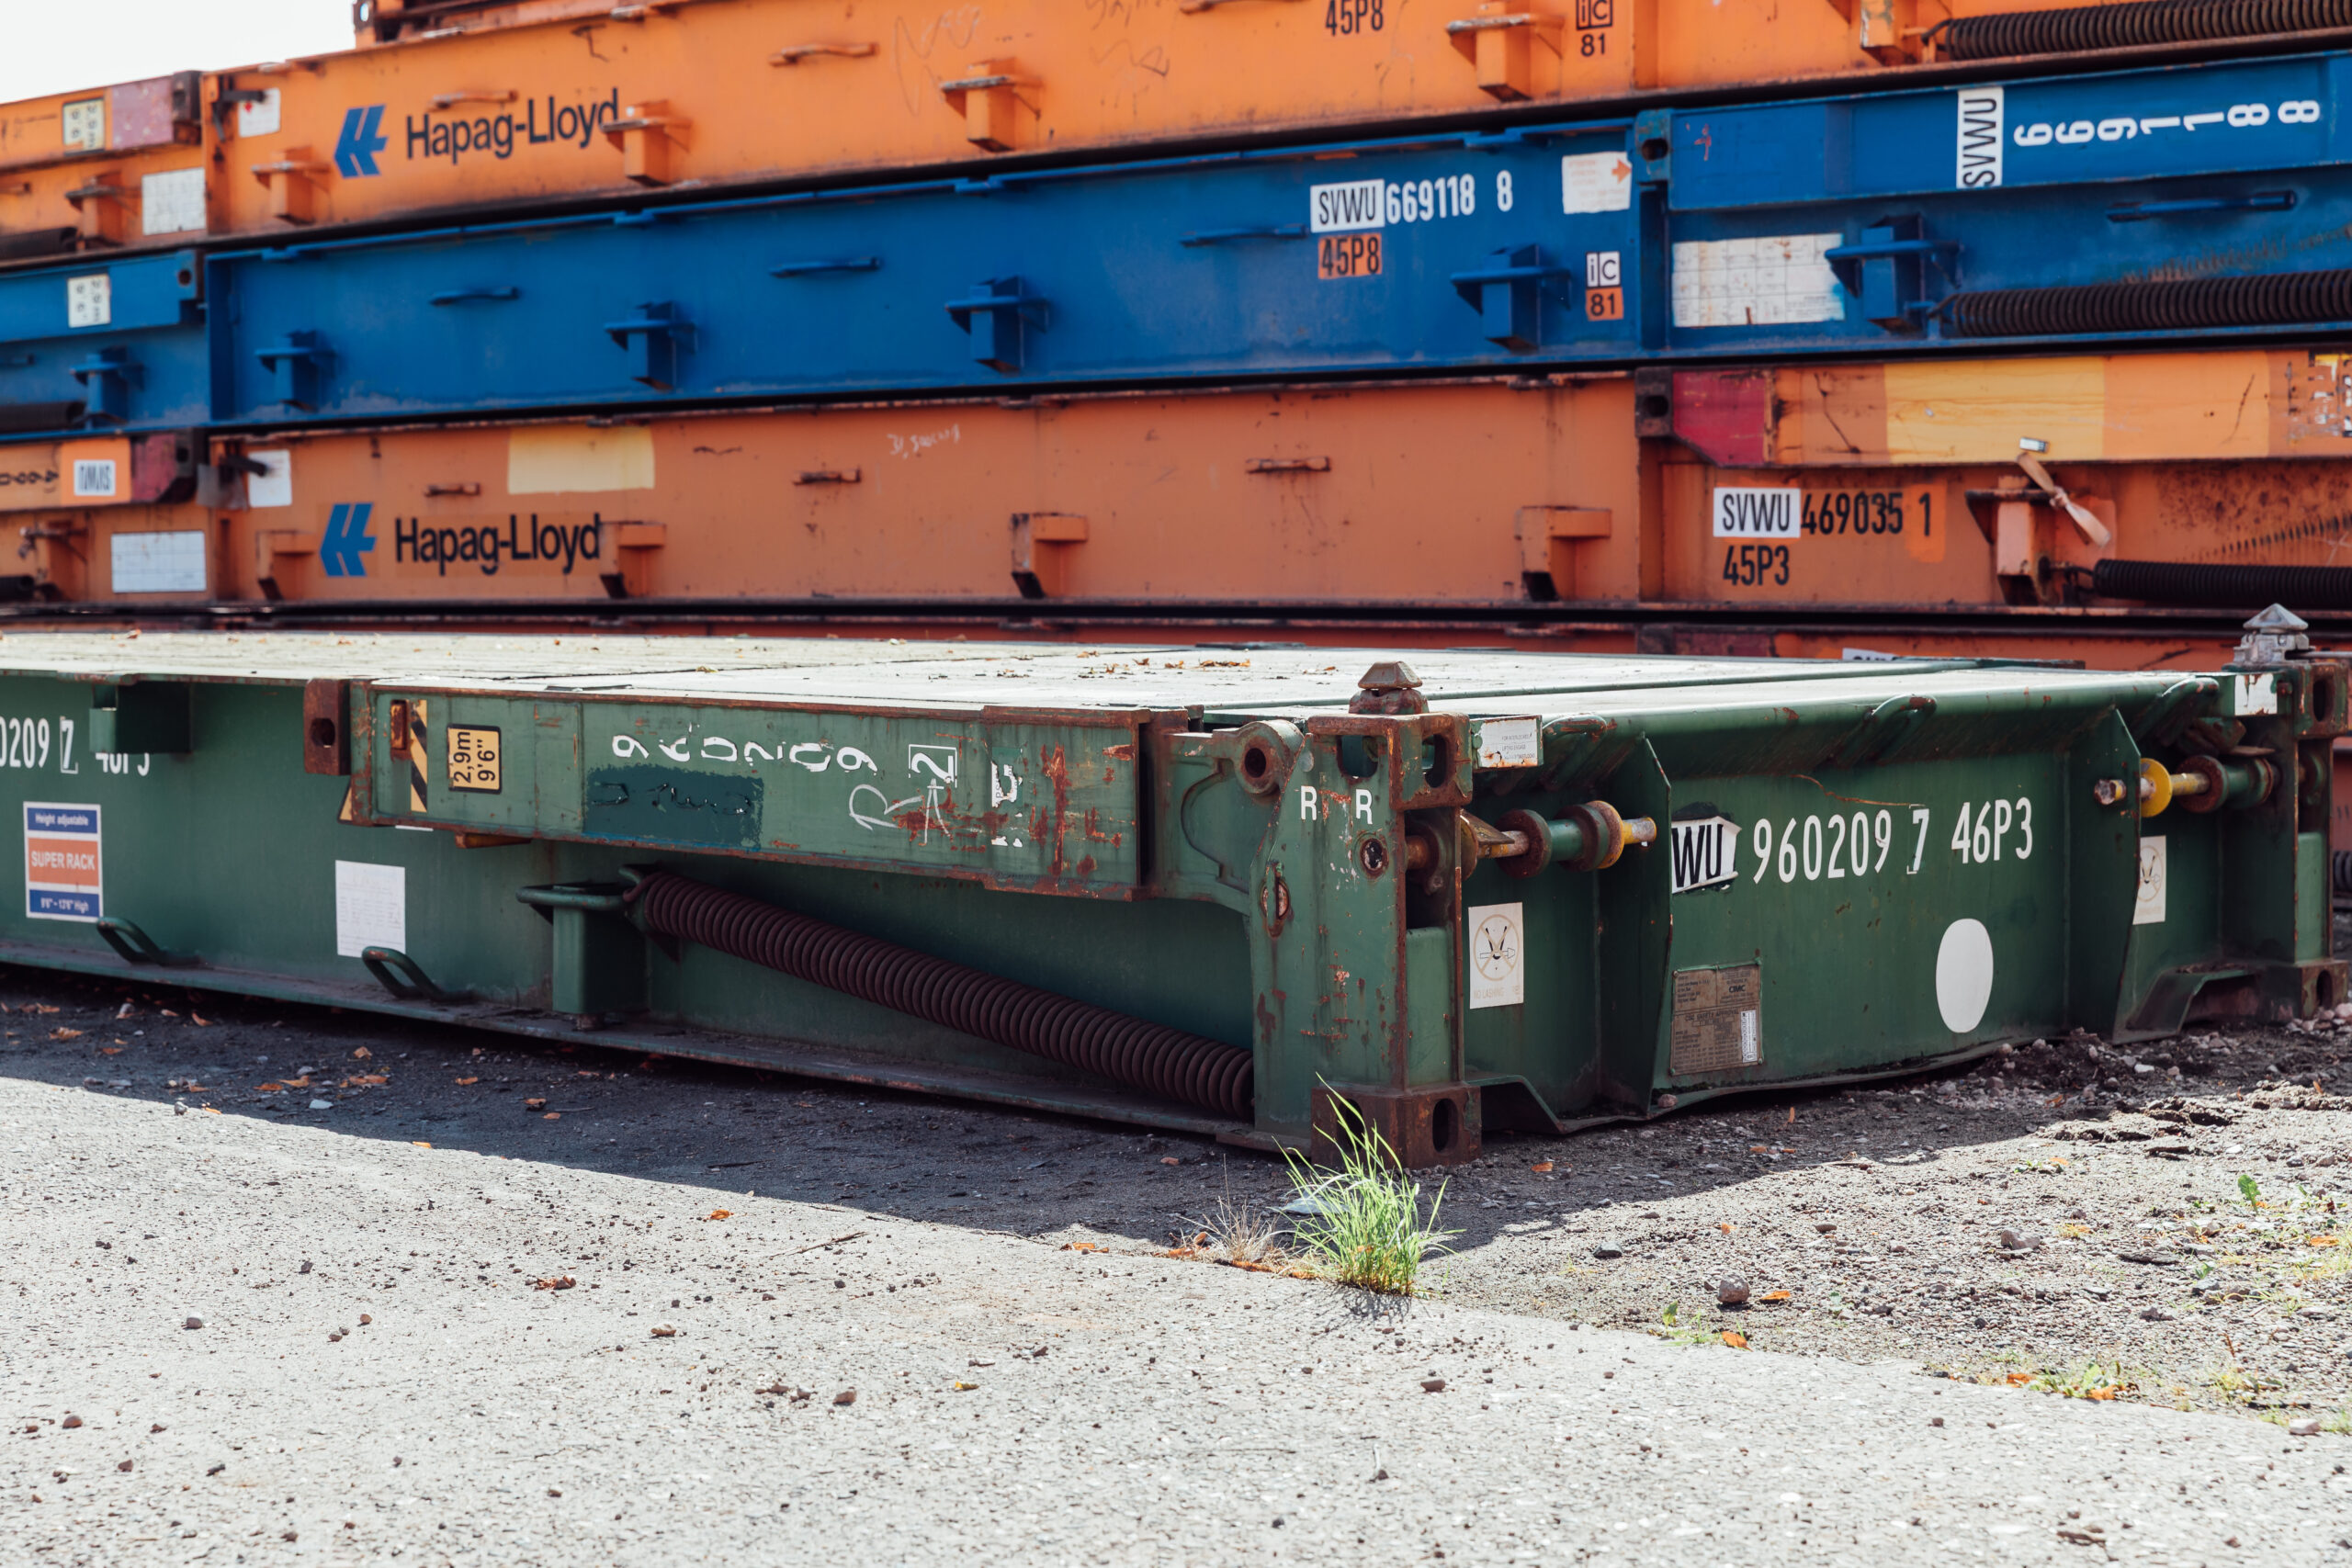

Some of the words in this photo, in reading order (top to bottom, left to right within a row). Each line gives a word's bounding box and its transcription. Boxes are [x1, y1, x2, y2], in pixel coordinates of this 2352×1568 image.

[1326, 0, 1384, 37] 45P8
[1581, 33, 1605, 57] 81
[406, 86, 618, 165] Hapag-Lloyd
[1962, 97, 1998, 187] SVWU
[2013, 102, 2270, 147] 669118
[2278, 99, 2321, 124] 8
[1319, 186, 1376, 225] SVWU
[1385, 174, 1476, 224] 669118
[1497, 170, 1514, 212] 8
[1321, 236, 1380, 276] 45P8
[1590, 293, 1614, 317] 81
[1722, 493, 1791, 532] SVWU
[1801, 491, 1904, 536] 469035
[1918, 492, 1931, 536] 1
[395, 512, 601, 576] Hapag-Lloyd
[1722, 545, 1790, 585] 45P3
[453, 731, 474, 784] 2,9m
[1301, 785, 1317, 820] R
[1356, 789, 1374, 824] R
[30, 850, 64, 869] SUPER
[66, 852, 96, 871] RACK
[1753, 809, 1892, 885] 960209
[1912, 808, 1929, 872] 7
[1951, 796, 2033, 864] 46P3
